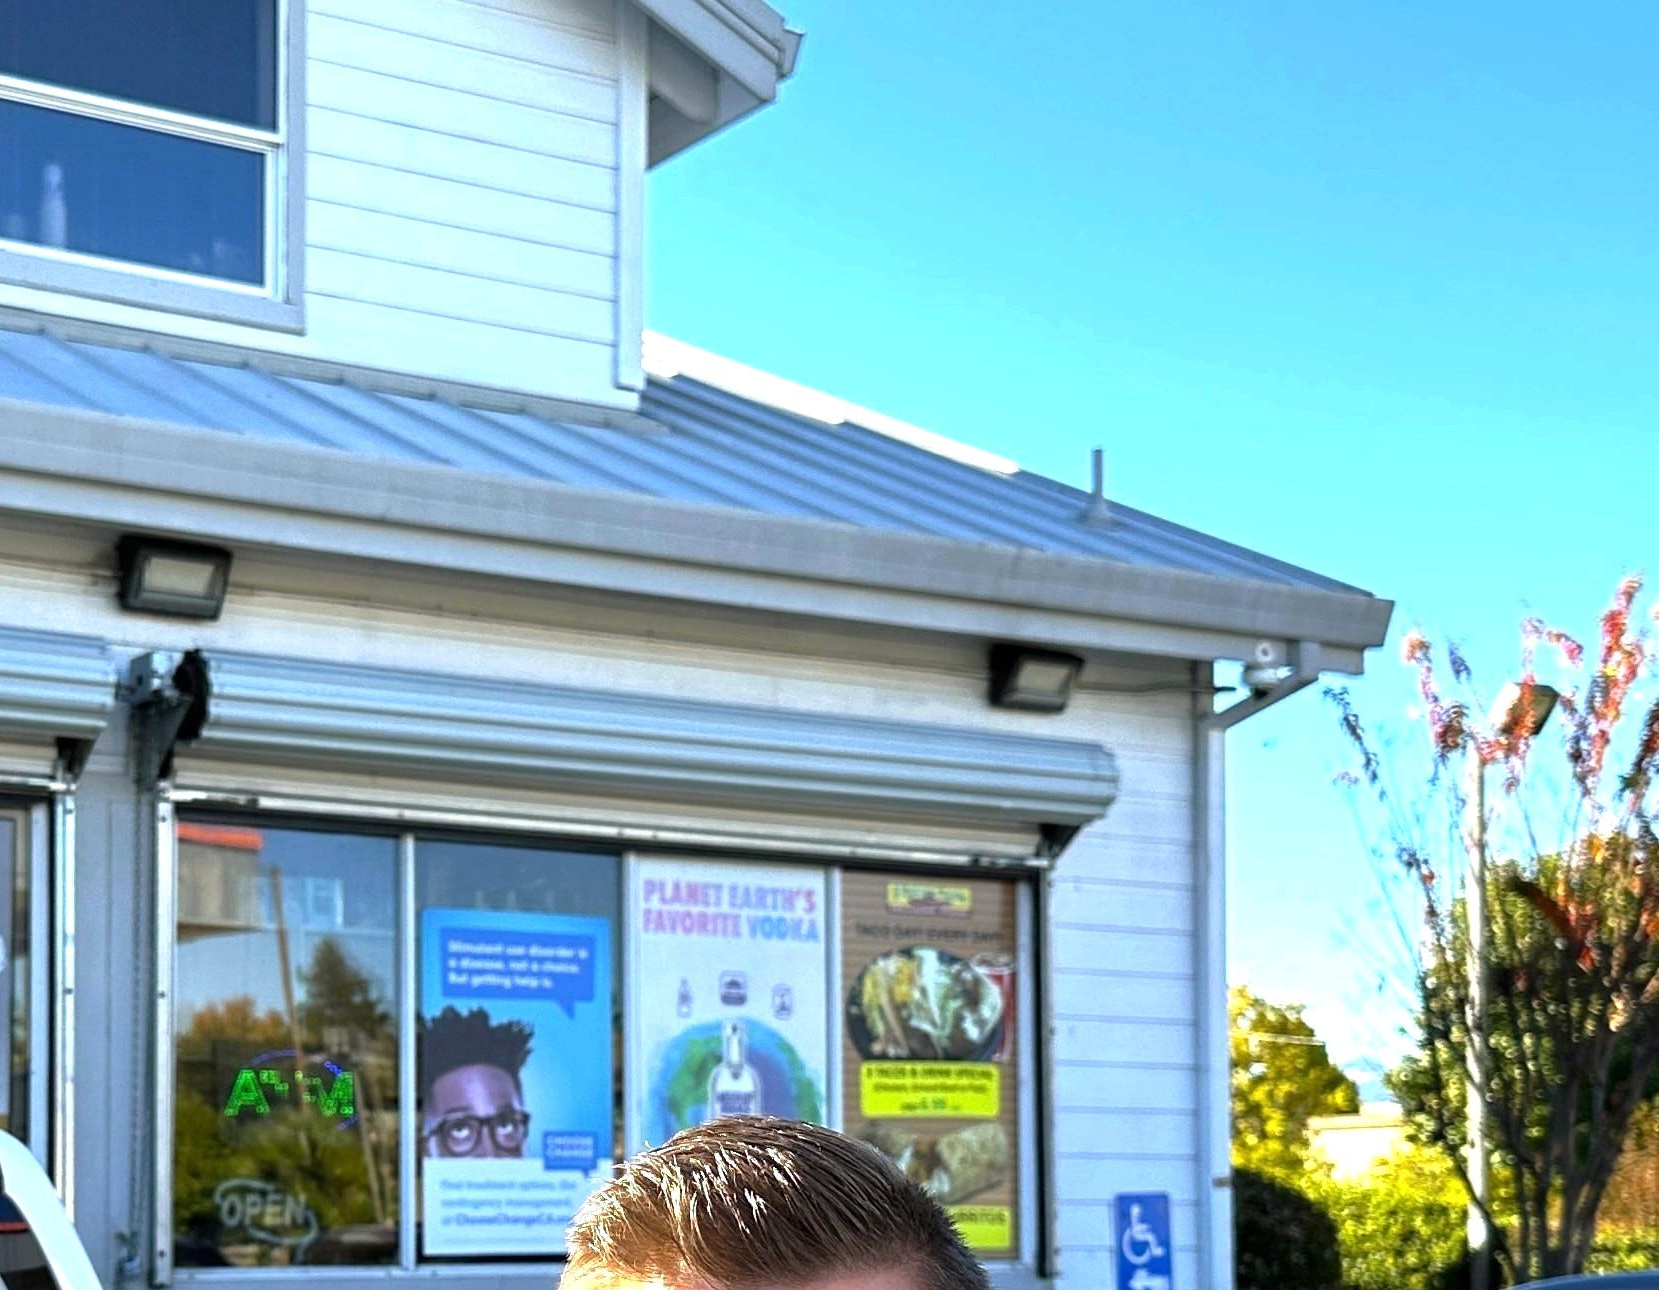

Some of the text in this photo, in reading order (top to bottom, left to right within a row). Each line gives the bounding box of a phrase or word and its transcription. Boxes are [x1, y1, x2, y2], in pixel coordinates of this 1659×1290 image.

[643, 879, 816, 914] PLANET EARTH'S
[643, 908, 819, 942] FAVORITE VODKA
[221, 1190, 307, 1228] OPEN
